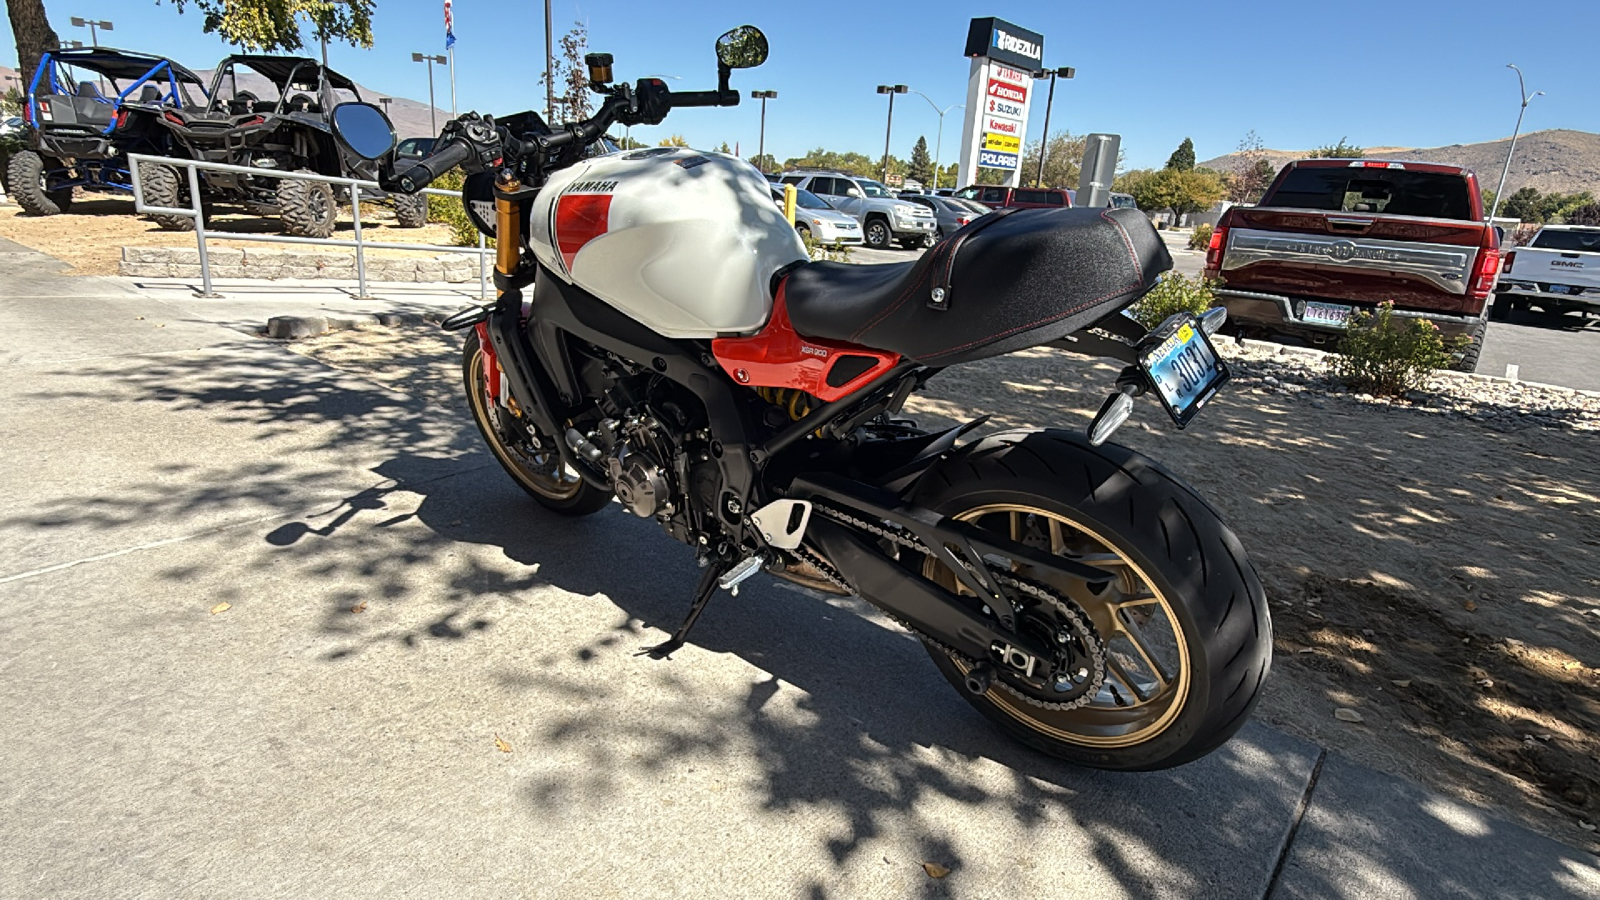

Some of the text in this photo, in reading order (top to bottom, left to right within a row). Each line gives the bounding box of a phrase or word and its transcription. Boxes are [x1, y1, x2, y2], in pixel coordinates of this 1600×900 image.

[1004, 34, 1041, 61] RIDEZILLA
[997, 86, 1024, 102] HONDA
[997, 103, 1021, 117] SUZUKI
[990, 119, 1017, 133] Kawasaki
[980, 152, 1017, 167] POLARIS
[567, 181, 619, 193] YAMAHA
[1551, 260, 1585, 269] GMC
[813, 347, 828, 358] 900
[1171, 340, 1213, 392] 3031
